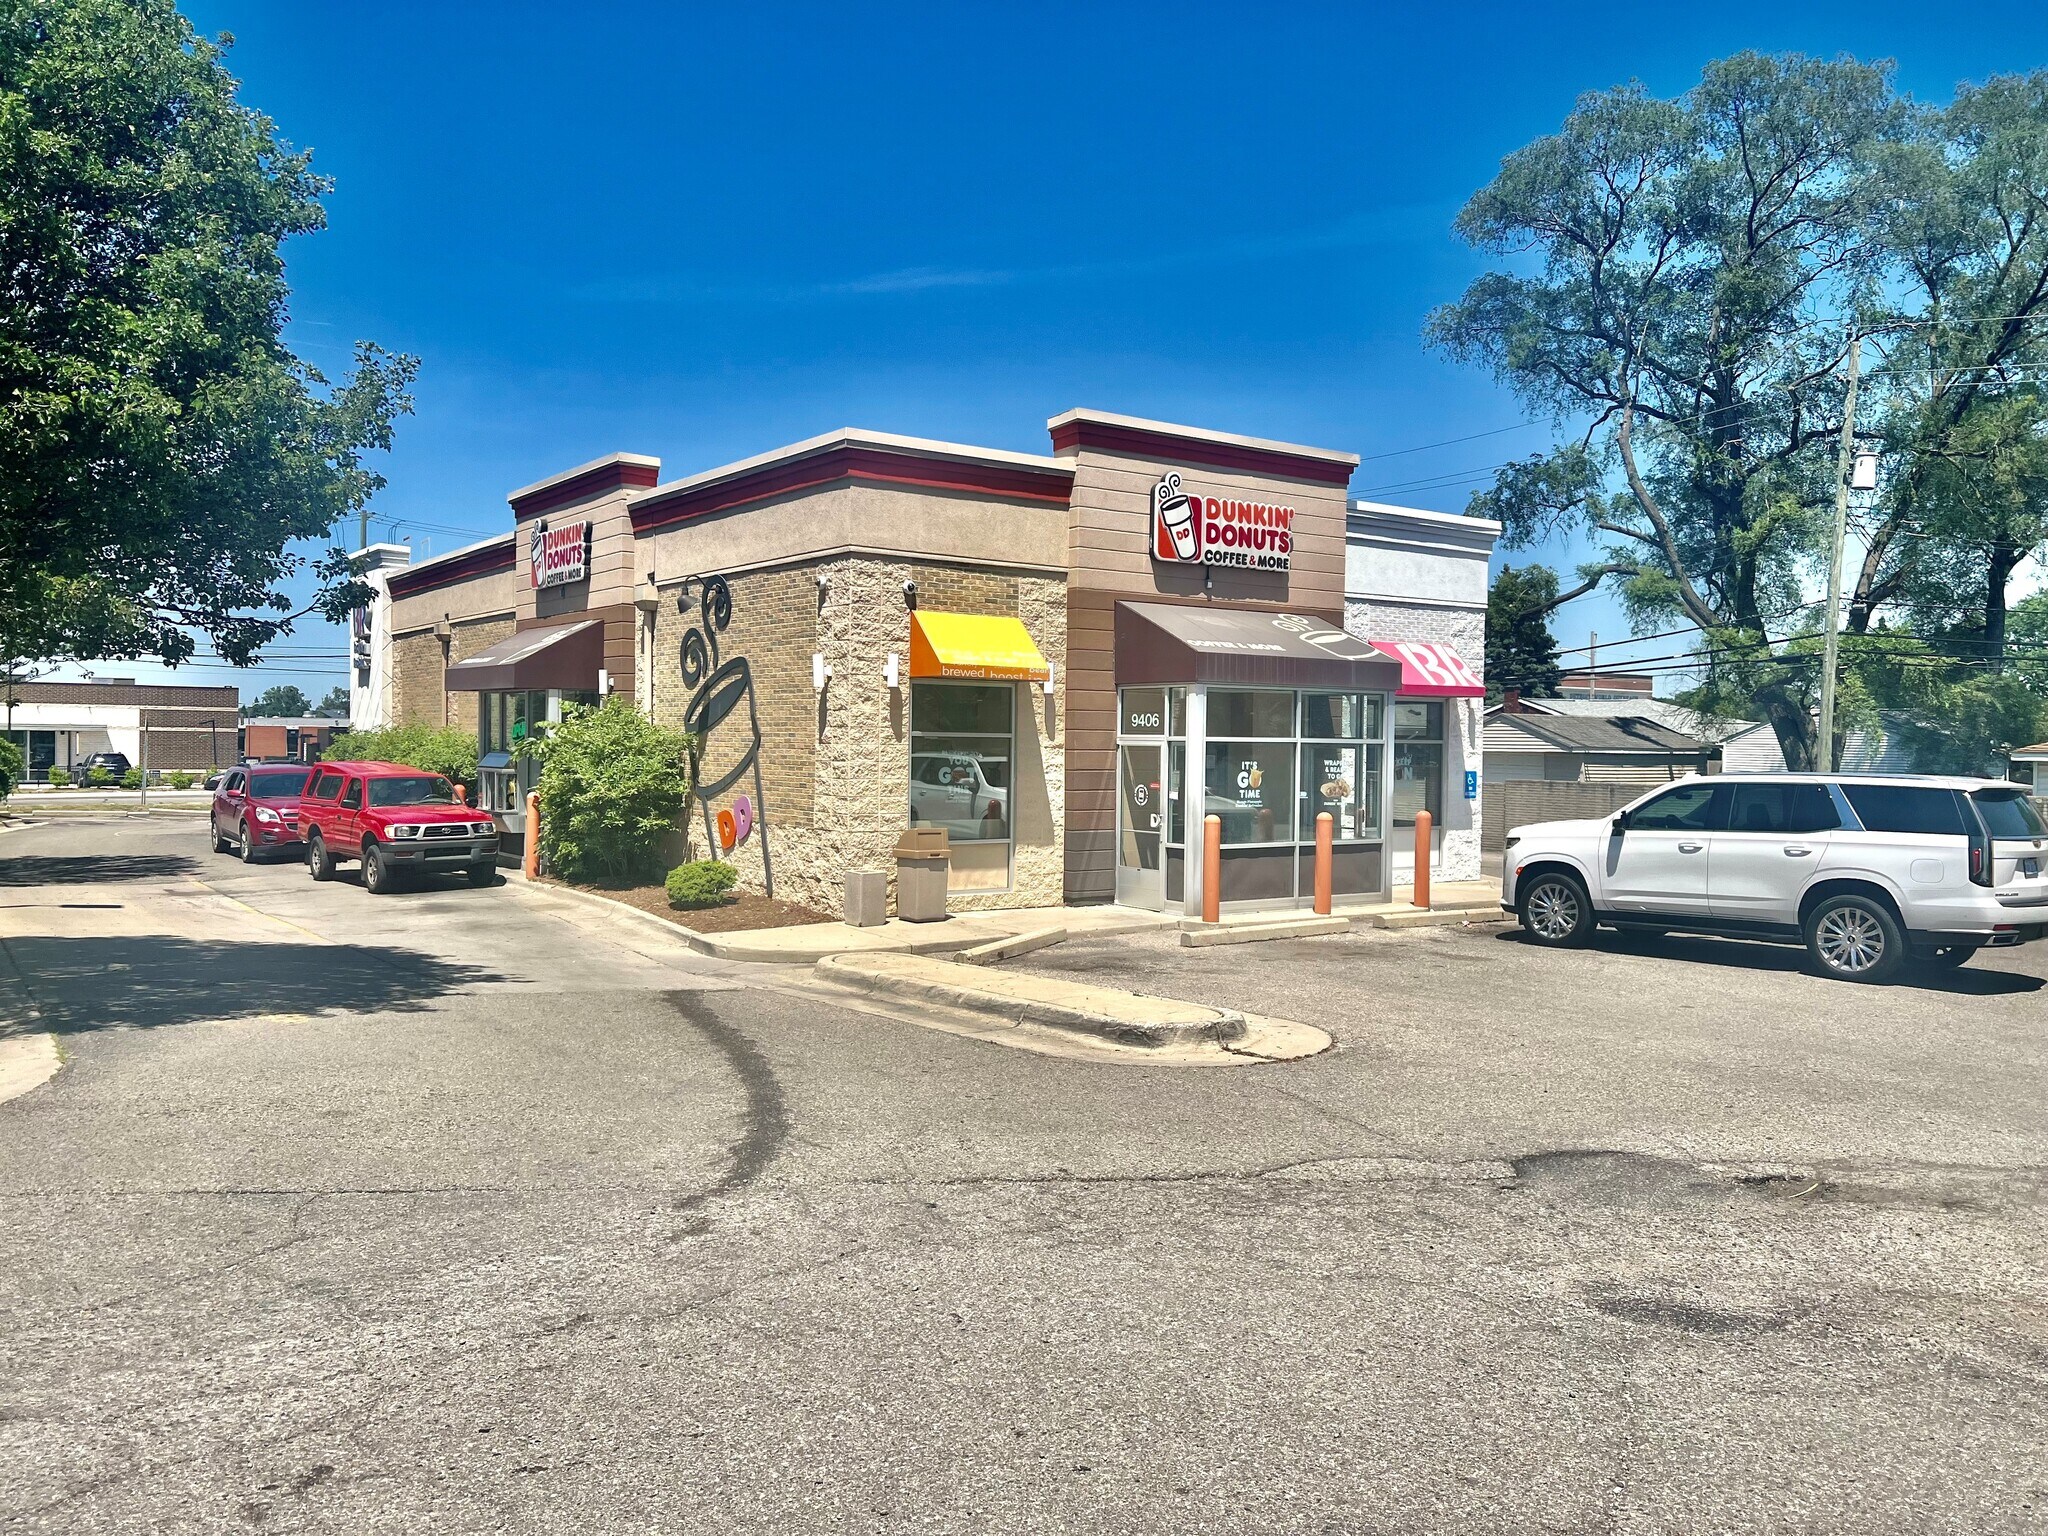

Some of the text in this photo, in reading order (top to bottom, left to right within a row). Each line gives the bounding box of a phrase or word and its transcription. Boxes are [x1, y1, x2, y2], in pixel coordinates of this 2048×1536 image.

[1206, 498, 1295, 530] DUNKIN'
[547, 522, 584, 551] DUNKIN'
[1176, 528, 1190, 541] DD
[1206, 522, 1290, 554] DONUTS
[547, 544, 583, 571] DONUTS
[1204, 549, 1289, 570] COFFEE & MORE
[547, 571, 564, 585] COFFEE
[568, 567, 582, 580] MORE
[941, 665, 985, 678] brewed
[1131, 713, 1160, 727] 9406
[1242, 761, 1258, 770] IT'S
[1239, 790, 1261, 798] TIME
